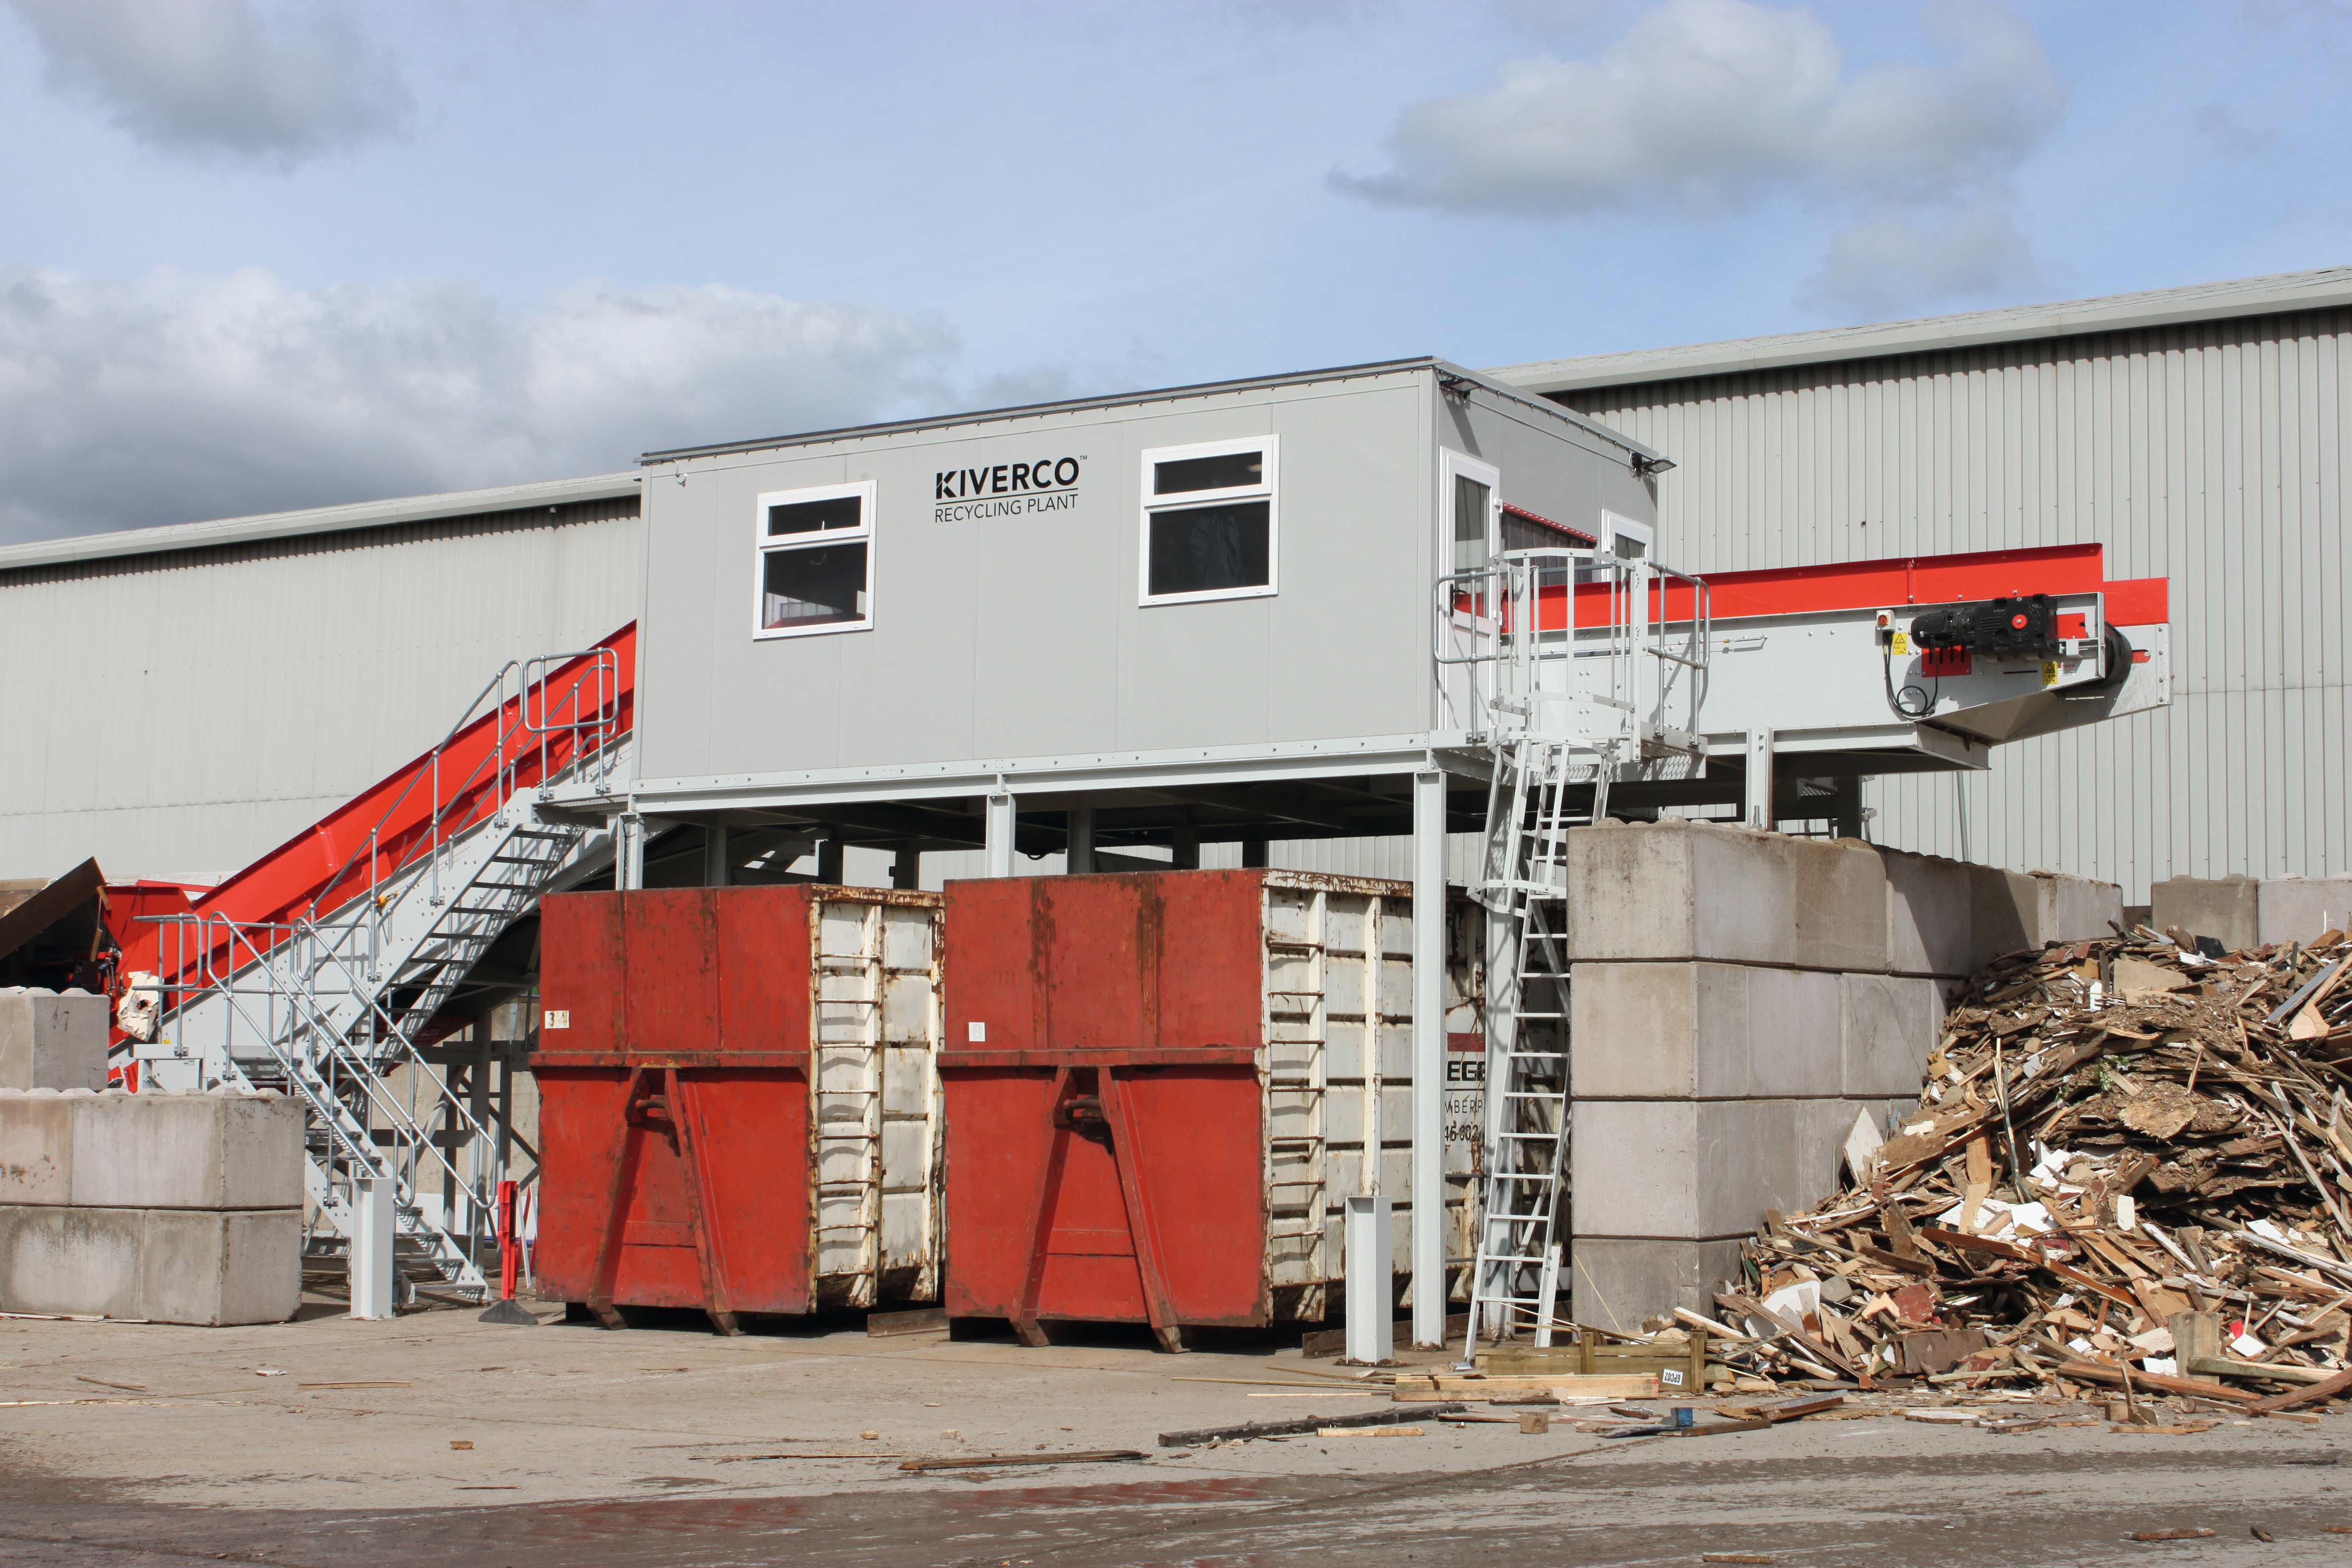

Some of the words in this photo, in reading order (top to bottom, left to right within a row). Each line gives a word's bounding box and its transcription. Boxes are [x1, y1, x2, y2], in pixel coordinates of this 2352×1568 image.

[936, 457, 1079, 499] KIVERCO
[935, 500, 1021, 523] RECYCLING
[1028, 494, 1078, 513] PLANT
